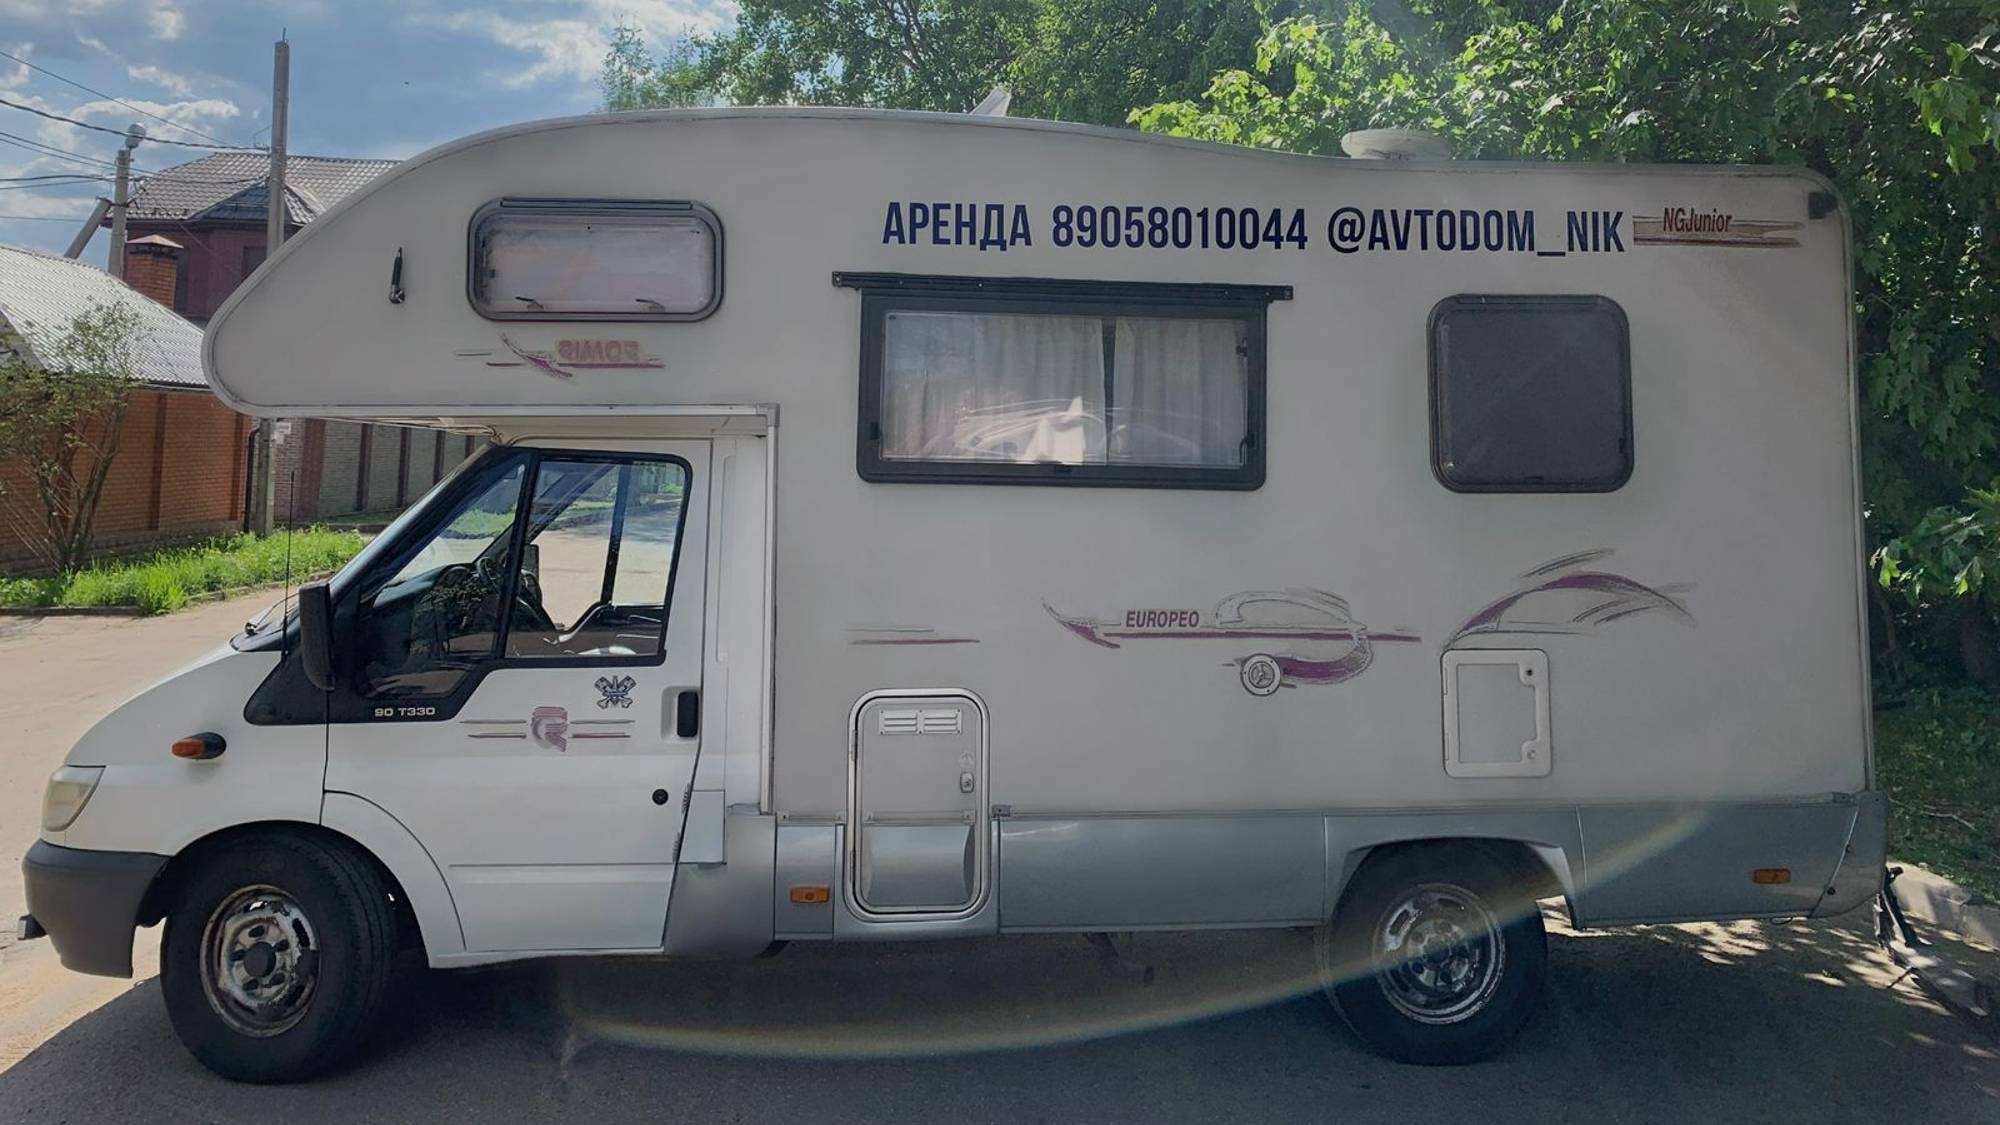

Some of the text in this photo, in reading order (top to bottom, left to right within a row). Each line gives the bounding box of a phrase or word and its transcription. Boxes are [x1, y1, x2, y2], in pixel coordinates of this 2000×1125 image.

[882, 201, 1625, 257] АРЕНДА 89058010044 @AVTODOM_NIK
[1662, 206, 1733, 233] NGJunior
[1125, 610, 1200, 629] EUROPEO
[374, 706, 436, 717] 90 T330
